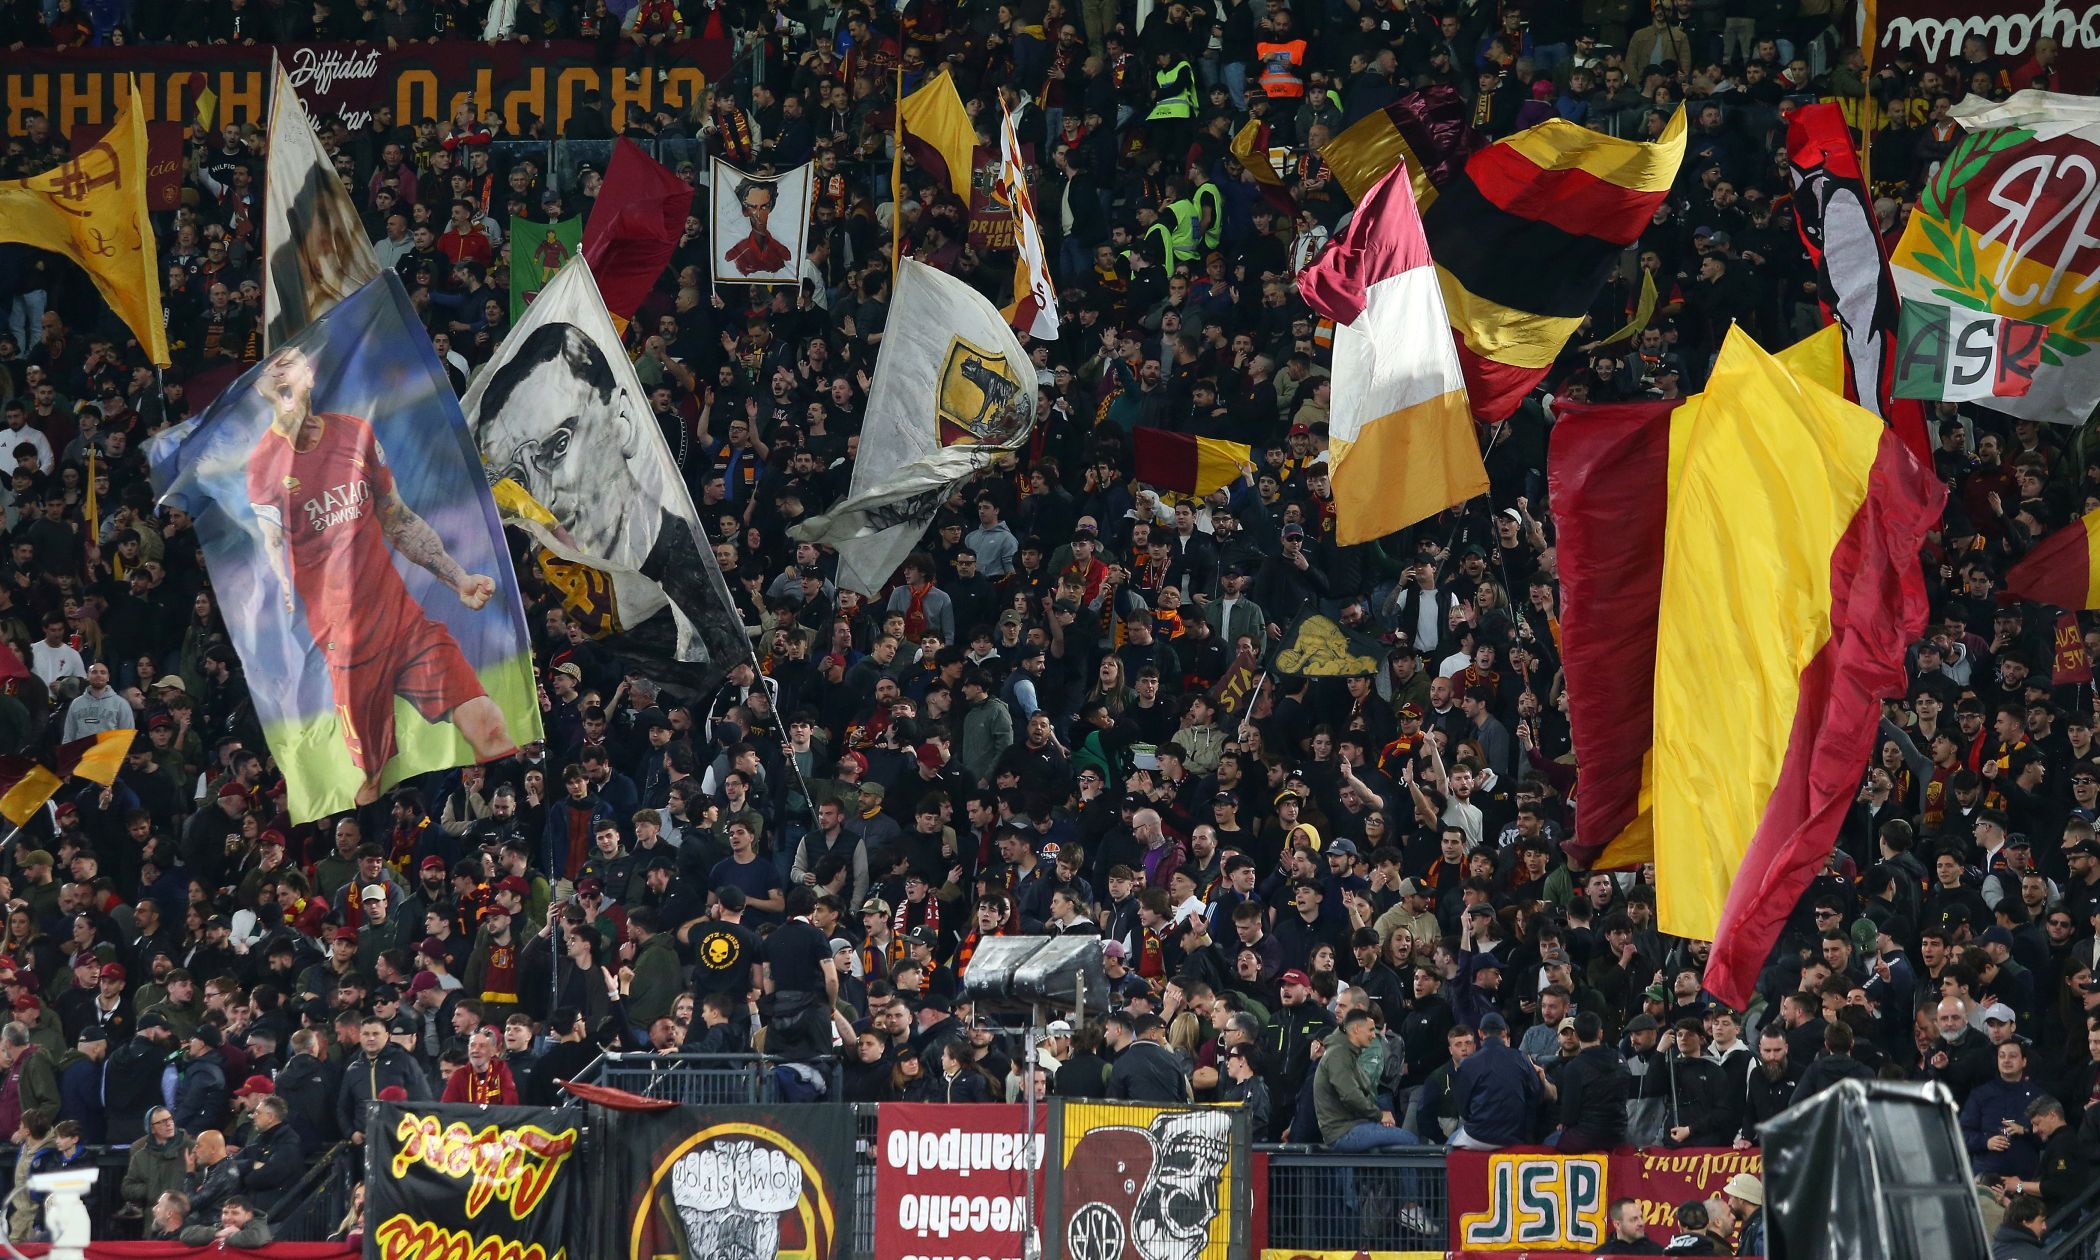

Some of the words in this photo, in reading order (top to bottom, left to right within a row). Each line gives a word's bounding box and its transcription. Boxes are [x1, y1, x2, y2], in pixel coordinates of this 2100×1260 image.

[289, 48, 382, 95] Diffidati
[210, 163, 238, 174] HILFIG
[984, 233, 1017, 249] TEA
[1898, 317, 2047, 387] ASR
[887, 1128, 1046, 1177] manipolo
[898, 1194, 1028, 1238] vecchio
